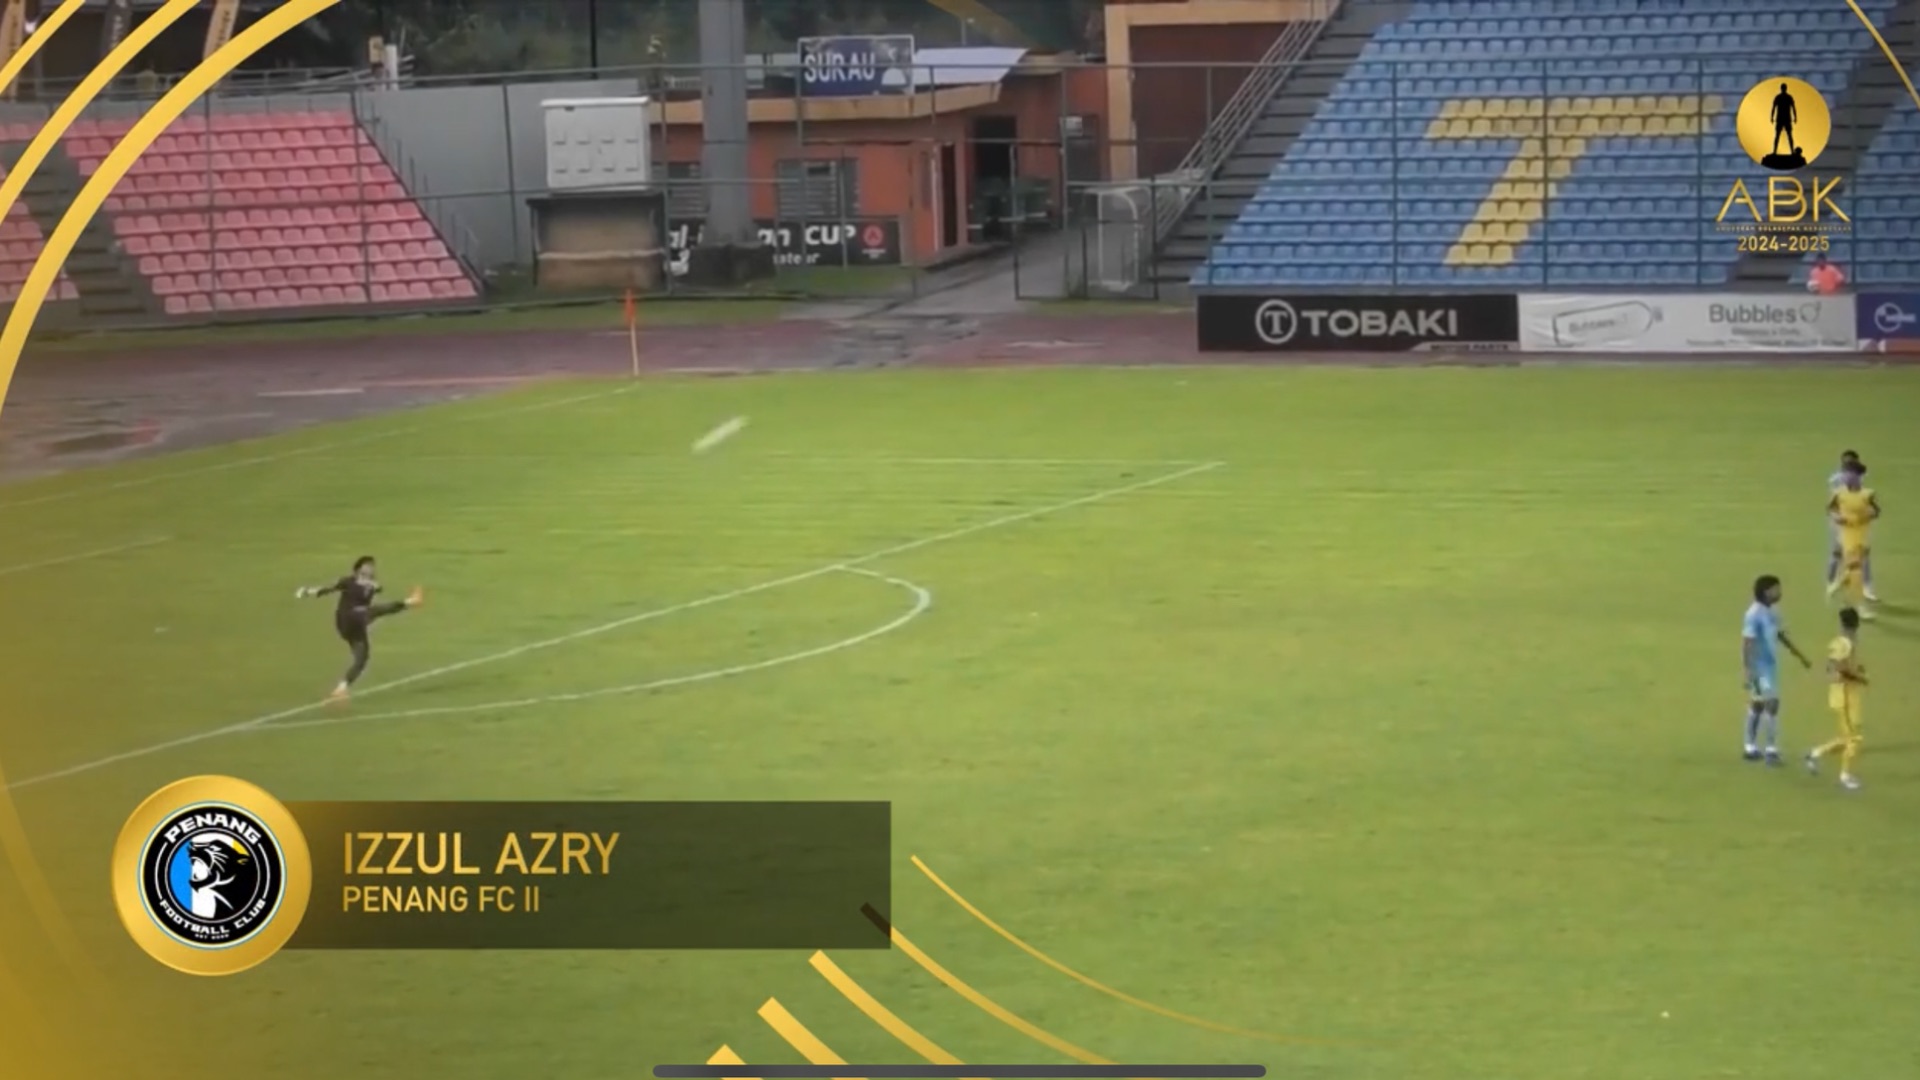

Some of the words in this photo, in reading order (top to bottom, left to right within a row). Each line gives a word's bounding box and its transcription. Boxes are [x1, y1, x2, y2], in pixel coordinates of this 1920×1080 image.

[804, 51, 876, 83] SURAU
[804, 225, 856, 245] CUP
[1301, 310, 1458, 337] TOBAKI
[1709, 304, 1797, 324] Bubbles
